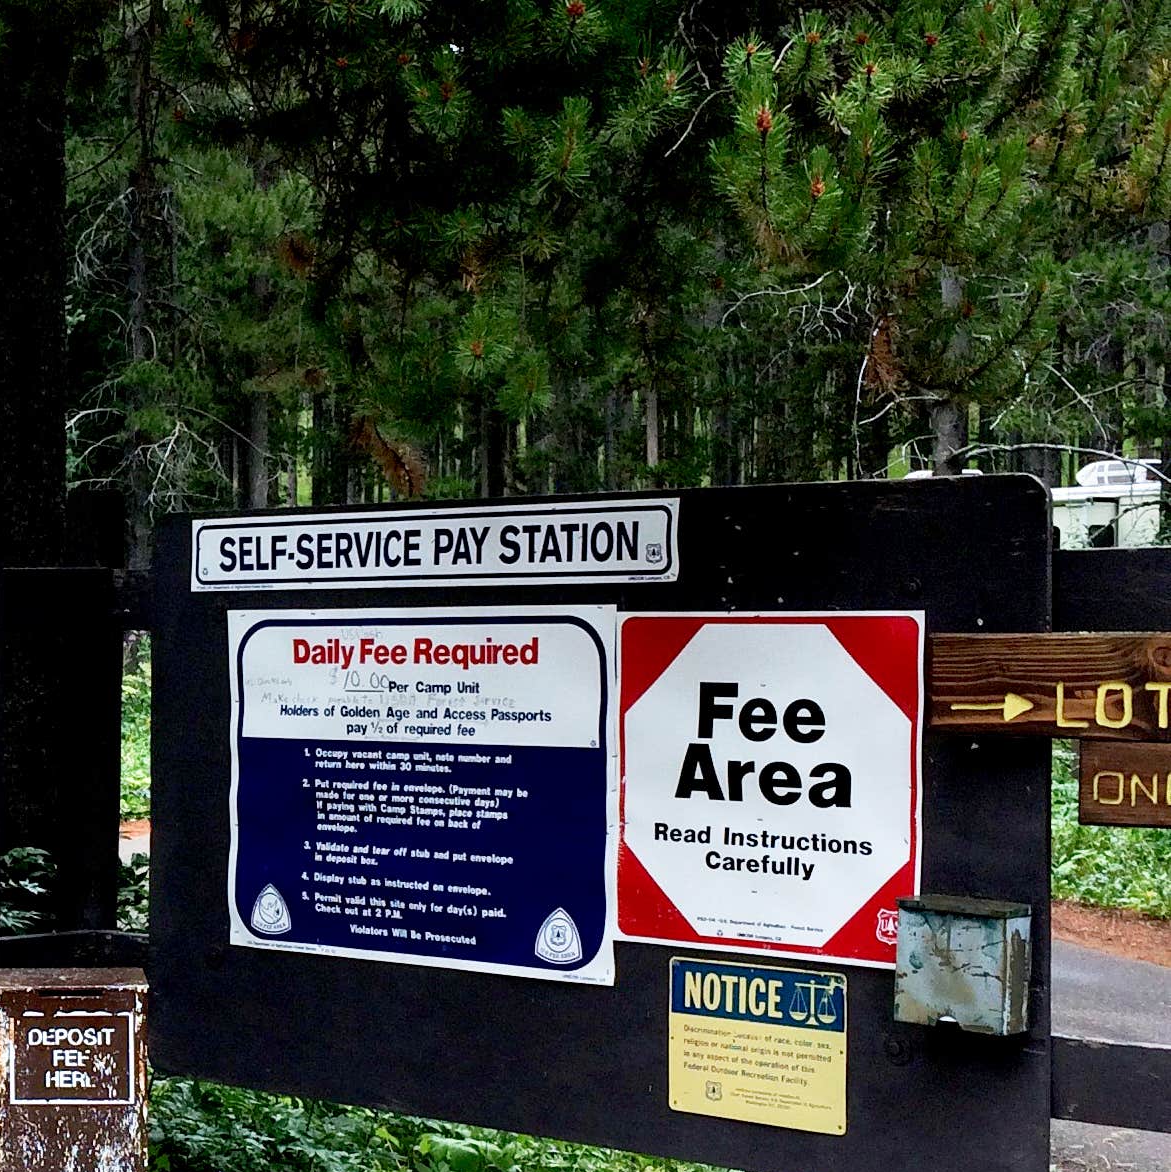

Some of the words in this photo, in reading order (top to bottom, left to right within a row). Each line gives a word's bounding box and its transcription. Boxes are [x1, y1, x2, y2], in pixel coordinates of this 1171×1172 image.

[220, 529, 421, 572] SELF-SERVICE
[434, 527, 490, 565] PAY
[499, 521, 639, 564] STATION
[293, 639, 354, 669] Daily
[360, 639, 407, 665] Fee
[414, 637, 539, 669] Required
[389, 681, 408, 692] Per
[416, 681, 451, 695] Camp
[457, 682, 480, 693] Unit
[280, 705, 319, 716] Holders
[324, 706, 335, 716] of
[340, 706, 380, 717] Golden
[386, 707, 410, 720] Age
[416, 708, 437, 719] and
[444, 708, 486, 720] Access
[491, 708, 552, 723] Passports
[698, 682, 825, 743] Fee
[1056, 682, 1171, 728] LOT
[347, 723, 367, 735] pay
[387, 722, 398, 734] of
[404, 723, 451, 736] required
[457, 724, 475, 736] fee
[316, 748, 348, 759] Occupy
[352, 750, 382, 759] vacant
[386, 753, 410, 761] camp
[436, 753, 454, 762] note
[458, 753, 491, 763] number
[495, 754, 512, 764] and
[315, 760, 341, 768] return
[345, 760, 365, 769] here
[369, 761, 396, 770] within
[400, 762, 411, 771] 30
[415, 763, 452, 773] minutes.
[675, 743, 851, 808] Area
[302, 779, 310, 787] 2.
[315, 779, 329, 788] Put
[333, 780, 369, 790] required
[373, 781, 387, 790] fee
[391, 782, 400, 791] in
[404, 784, 445, 794] envelope.
[449, 784, 490, 796] (Payment
[495, 789, 513, 798] may
[517, 788, 528, 797] be
[1093, 771, 1171, 807] ON
[316, 790, 339, 799] made
[343, 791, 355, 800] for
[419, 796, 470, 806] consecutive
[475, 797, 499, 809] days)
[316, 800, 322, 809] If
[327, 802, 354, 812] paying
[358, 803, 377, 812] with
[381, 804, 406, 815] Camp
[410, 805, 445, 817] Stamps,
[449, 808, 472, 817] place
[476, 810, 508, 820] stamps
[317, 811, 325, 820] in
[329, 814, 360, 822] amount
[364, 814, 373, 822] of
[377, 815, 413, 825] required
[417, 817, 430, 826] fee
[448, 819, 468, 828] back
[472, 820, 481, 829] of
[317, 823, 357, 833] envelope.
[654, 823, 711, 845] Read
[723, 827, 873, 856] Instructions
[304, 841, 311, 849] 3.
[316, 842, 349, 852] Validate
[353, 845, 369, 853] and
[373, 846, 390, 855] tear
[394, 848, 407, 856] off
[411, 849, 430, 858] stub
[434, 851, 449, 860] and
[453, 852, 466, 862] put
[470, 854, 513, 865] envelope
[315, 852, 322, 861] in
[326, 853, 357, 864] deposit
[361, 856, 378, 865] box.
[705, 851, 814, 881] Carefully
[301, 872, 309, 880] 4.
[314, 872, 344, 885] Display
[348, 876, 366, 885] stub
[385, 878, 429, 890] instructed
[448, 885, 491, 896] envelope.
[315, 892, 341, 903] Permit
[345, 896, 365, 905] valid
[370, 897, 386, 907] this
[390, 899, 405, 909] site
[409, 902, 426, 913] only
[431, 903, 443, 912] for
[447, 905, 477, 916] day(s)
[482, 908, 507, 918] paid.
[315, 903, 341, 913] Check
[345, 907, 358, 915] out
[375, 909, 381, 917] 2
[350, 924, 388, 936] Violators
[392, 928, 407, 938] Will
[411, 930, 421, 939] Be
[425, 932, 476, 945] Prosecuted
[684, 971, 783, 1019] NOTICE
[29, 1028, 116, 1045] DEPOSIT
[53, 1050, 90, 1067] FEE
[684, 1038, 709, 1048] religion
[751, 1046, 771, 1056] origin
[796, 1052, 831, 1063] permitted
[692, 1052, 704, 1061] any
[707, 1053, 729, 1063] aspect
[755, 1060, 788, 1071] operation
[684, 1062, 708, 1072] Federal
[741, 1070, 778, 1081] Recreation
